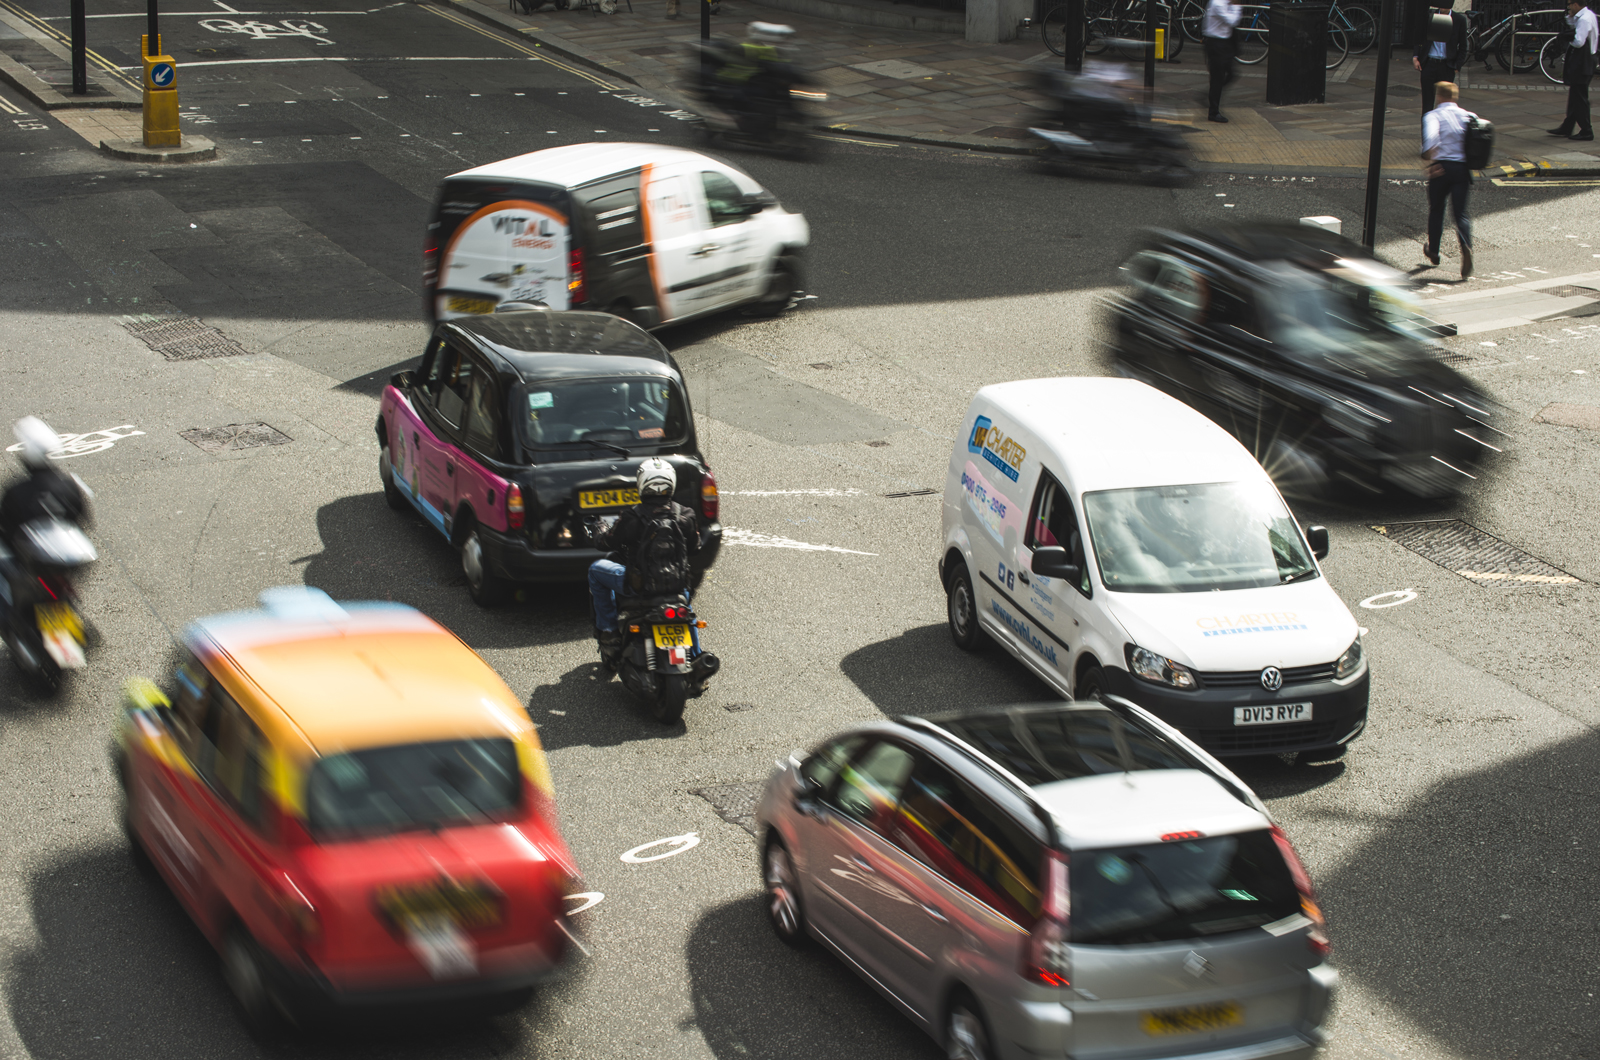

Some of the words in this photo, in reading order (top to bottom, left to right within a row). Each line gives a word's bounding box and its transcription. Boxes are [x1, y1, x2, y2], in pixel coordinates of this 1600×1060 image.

[490, 214, 557, 237] VITAL
[986, 426, 1026, 471] CHARTER
[1196, 612, 1299, 630] CHARTER
[657, 625, 685, 636] LC61
[1206, 626, 1263, 636] VEHICLE
[1272, 624, 1306, 632] HIRE
[661, 636, 685, 647] OYR
[1243, 707, 1274, 722] DV13
[1277, 705, 1304, 721] RYP
